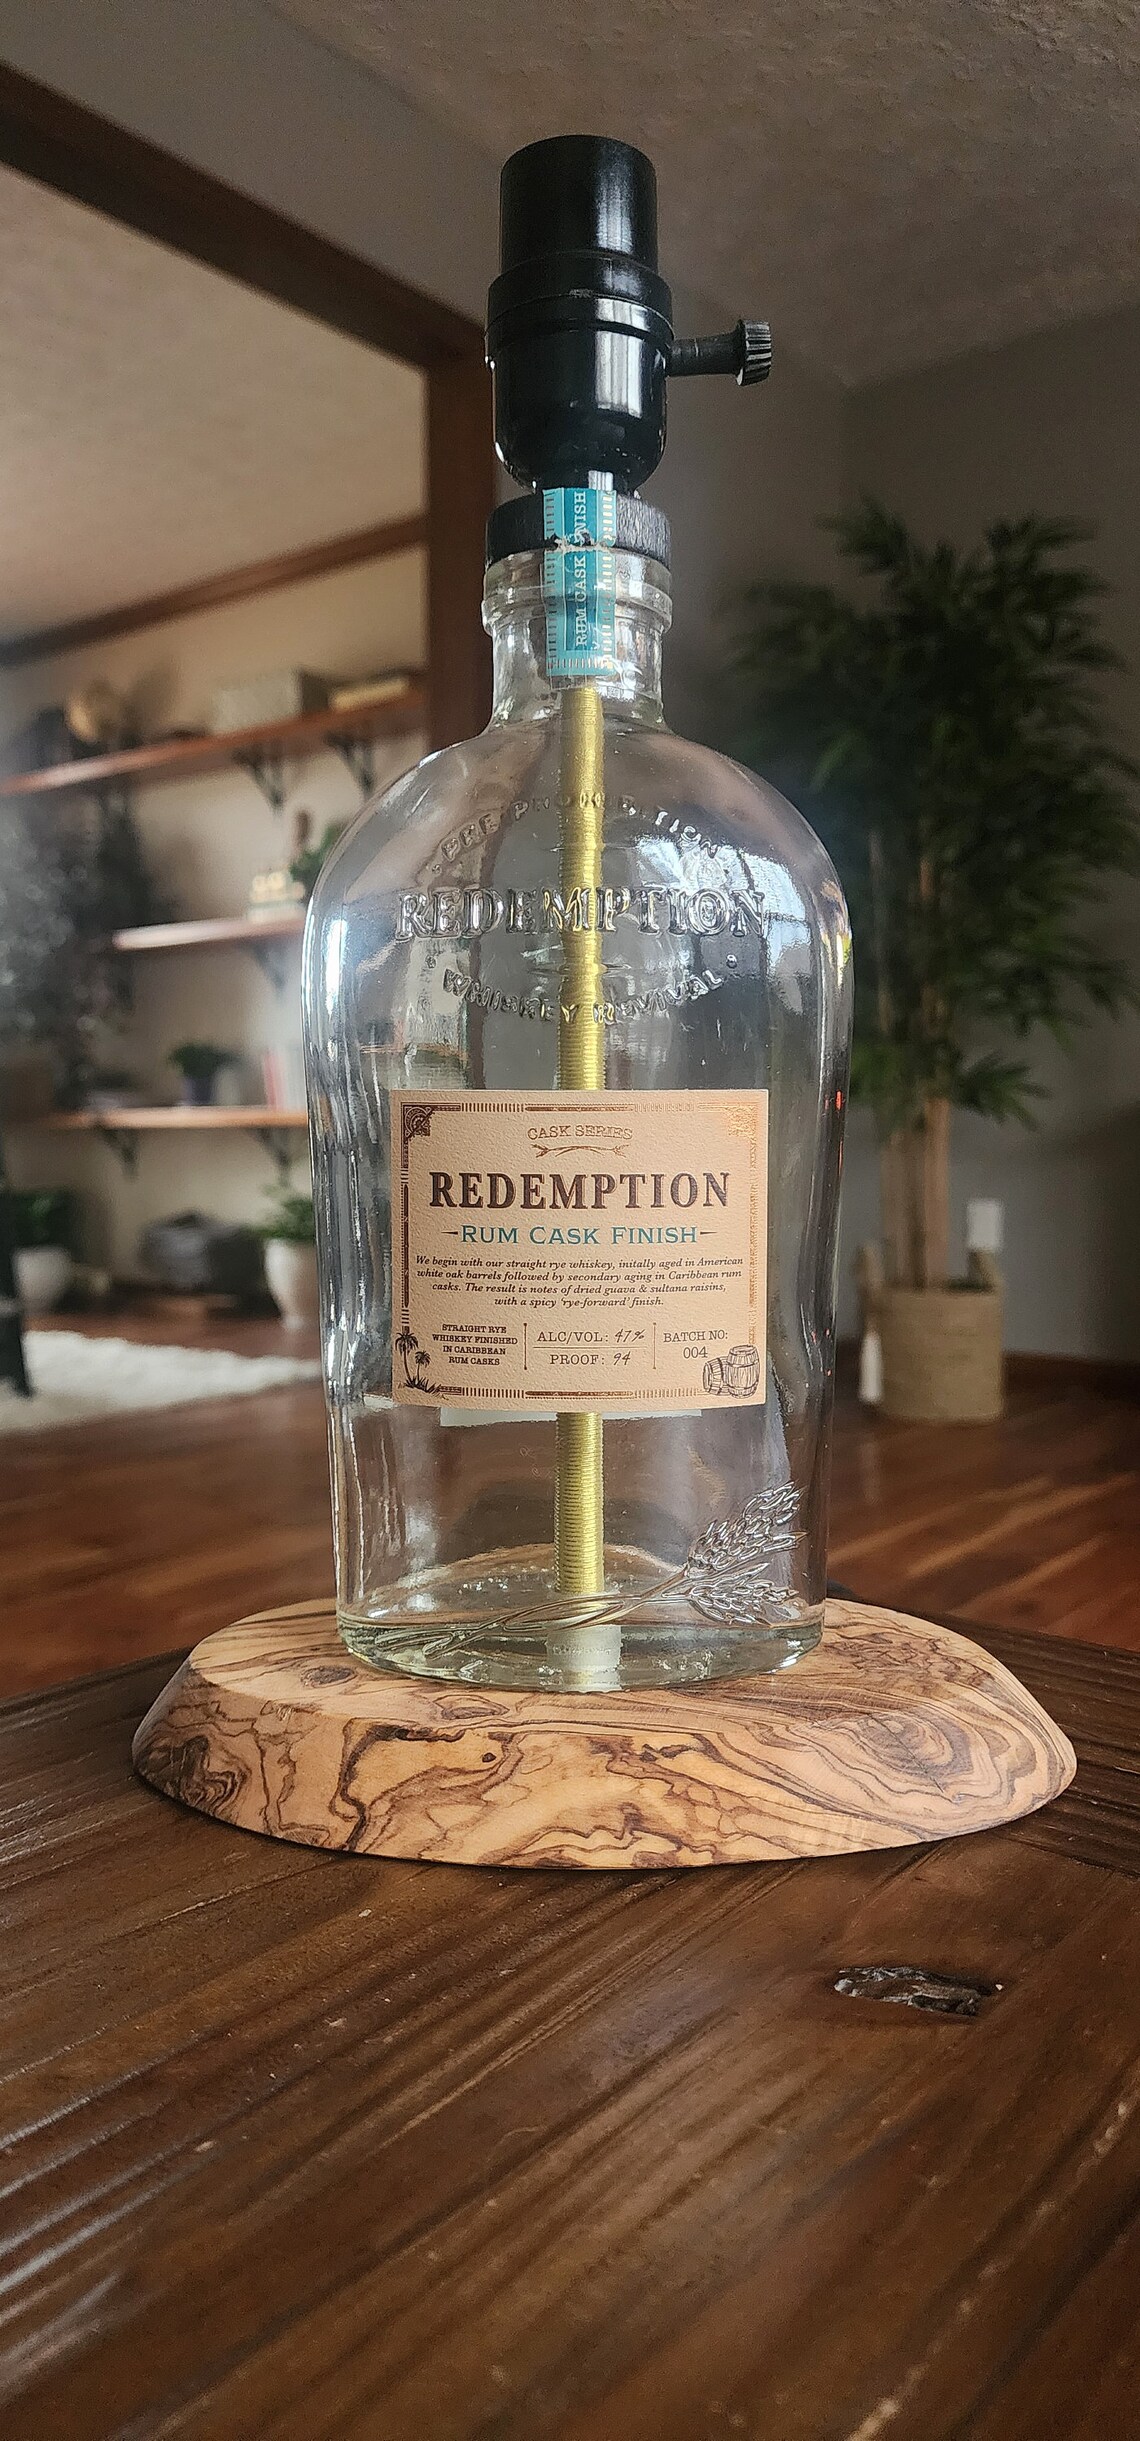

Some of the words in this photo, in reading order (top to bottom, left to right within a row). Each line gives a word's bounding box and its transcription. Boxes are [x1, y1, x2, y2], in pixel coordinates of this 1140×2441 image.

[574, 491, 588, 544] NISH
[574, 555, 588, 603] CASK
[575, 608, 588, 647] RUM
[395, 886, 765, 941] REDEMPTION
[527, 1125, 571, 1140] CASK
[575, 1125, 633, 1140] SERIES
[429, 1171, 730, 1209] REDEMPTION
[461, 1224, 518, 1244] RUM
[529, 1226, 600, 1245] CASK
[611, 1225, 698, 1245] FINISH
[416, 1255, 430, 1265] We
[432, 1256, 458, 1268] begin
[460, 1257, 483, 1267] with
[485, 1259, 503, 1267] our
[505, 1259, 546, 1270] straight
[549, 1261, 566, 1270] rye
[569, 1259, 616, 1271] whiskey,
[618, 1258, 656, 1270] initally
[658, 1257, 683, 1268] aged
[685, 1257, 695, 1267] in
[697, 1256, 743, 1267] American
[417, 1268, 443, 1278] white
[446, 1269, 464, 1279] oak
[466, 1270, 502, 1281] barrels
[502, 1271, 549, 1283] followed
[552, 1271, 565, 1284] by
[567, 1271, 621, 1284] secondary
[624, 1272, 652, 1284] aging
[655, 1271, 665, 1280] in
[668, 1269, 719, 1280] Caribbean
[721, 1269, 742, 1278] rum
[432, 1282, 461, 1292] casks.
[465, 1282, 483, 1292] The
[485, 1283, 515, 1293] result
[518, 1283, 527, 1293] is
[530, 1285, 558, 1294] notes
[560, 1284, 574, 1296] of
[573, 1284, 601, 1294] dried
[604, 1286, 635, 1296] guava
[638, 1284, 648, 1293] &
[650, 1283, 688, 1293] sultana
[690, 1282, 726, 1292] raisins,
[494, 1296, 517, 1306] with
[529, 1297, 557, 1308] spicy
[629, 1296, 664, 1308] finish.
[442, 1324, 487, 1333] STRAIGHT
[488, 1325, 507, 1334] RYE
[537, 1330, 609, 1344] ALC/VOL:
[614, 1328, 646, 1343] 47%
[663, 1331, 706, 1343] BATCH
[708, 1329, 728, 1341] NO:
[432, 1333, 473, 1343] WHISKEY
[474, 1336, 518, 1345] FINISHED
[442, 1345, 452, 1353] IN
[454, 1346, 506, 1355] CARIBBEAN
[683, 1346, 708, 1359] 004
[448, 1356, 469, 1365] RUM
[470, 1357, 500, 1366] CASKS
[550, 1354, 605, 1366] PROOF:
[613, 1351, 631, 1366] 94
